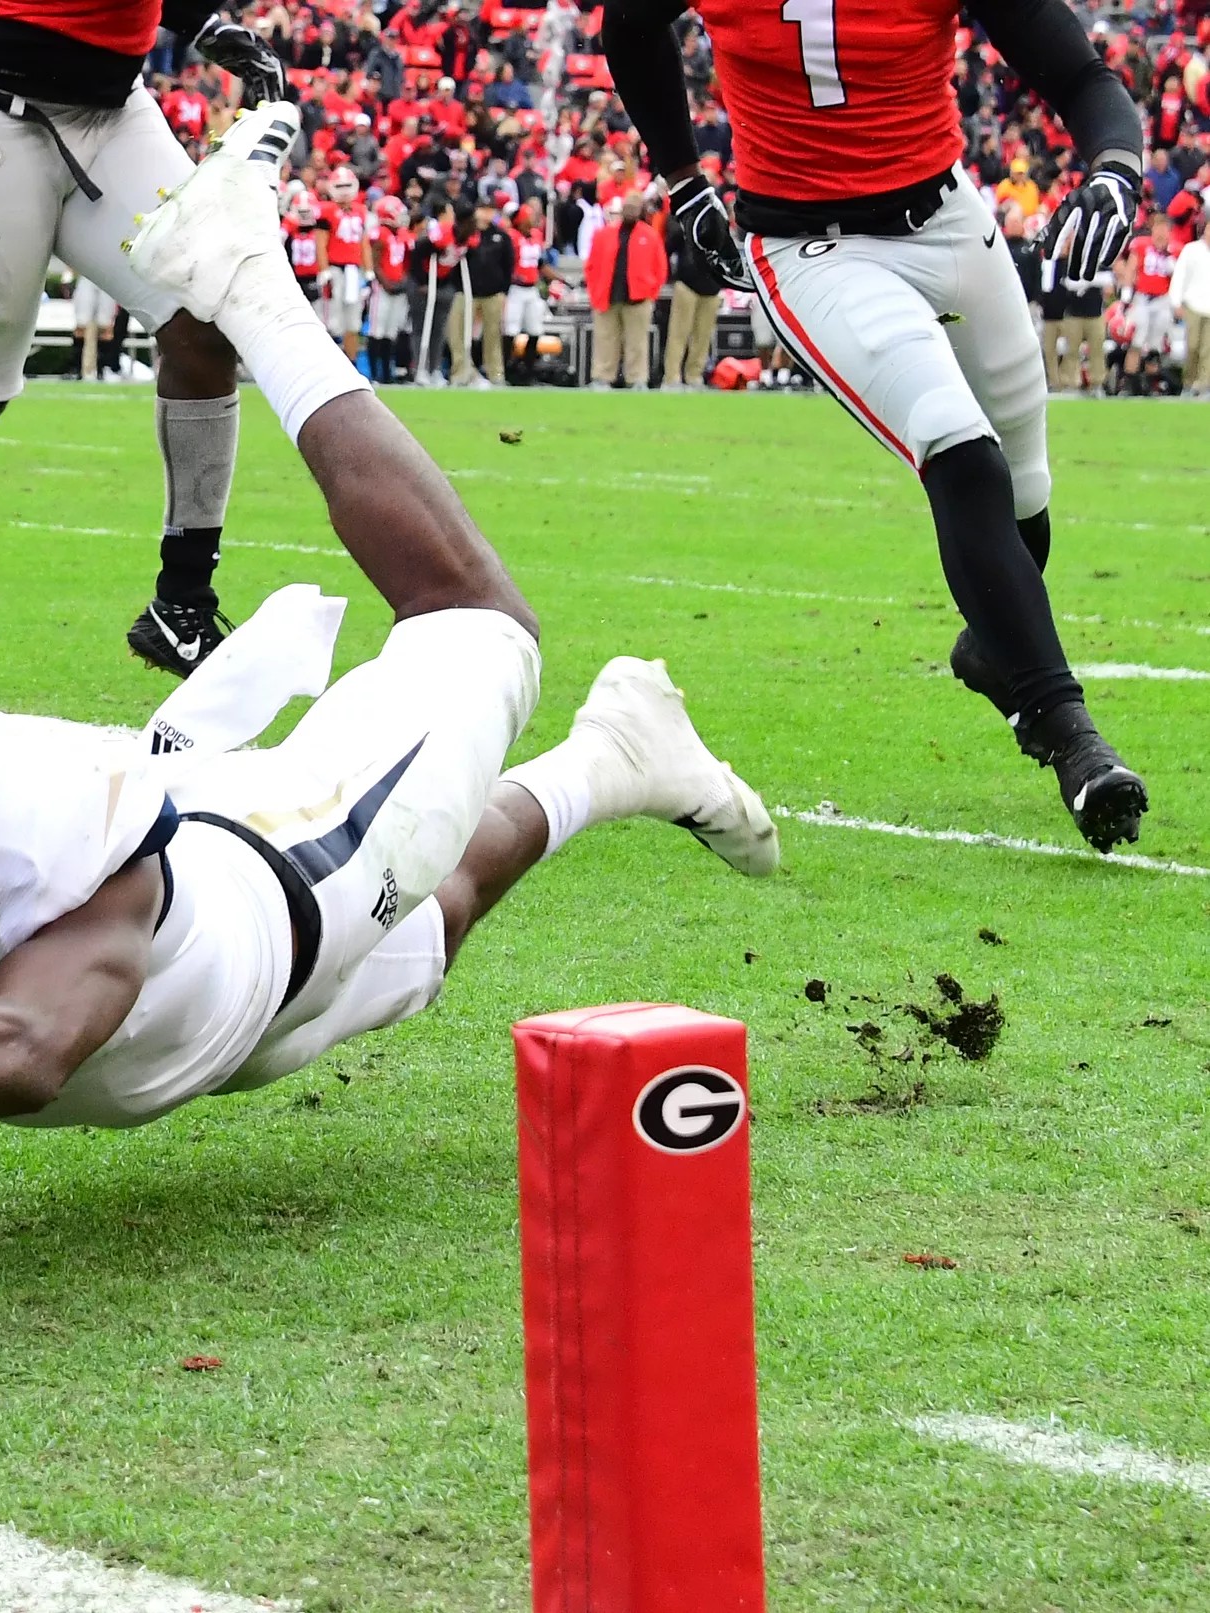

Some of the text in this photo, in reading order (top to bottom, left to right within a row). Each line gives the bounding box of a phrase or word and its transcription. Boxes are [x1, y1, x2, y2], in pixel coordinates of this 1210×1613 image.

[781, 0, 846, 107] 1
[797, 239, 838, 259] G
[153, 717, 194, 749] adidas
[638, 1069, 742, 1151] G
